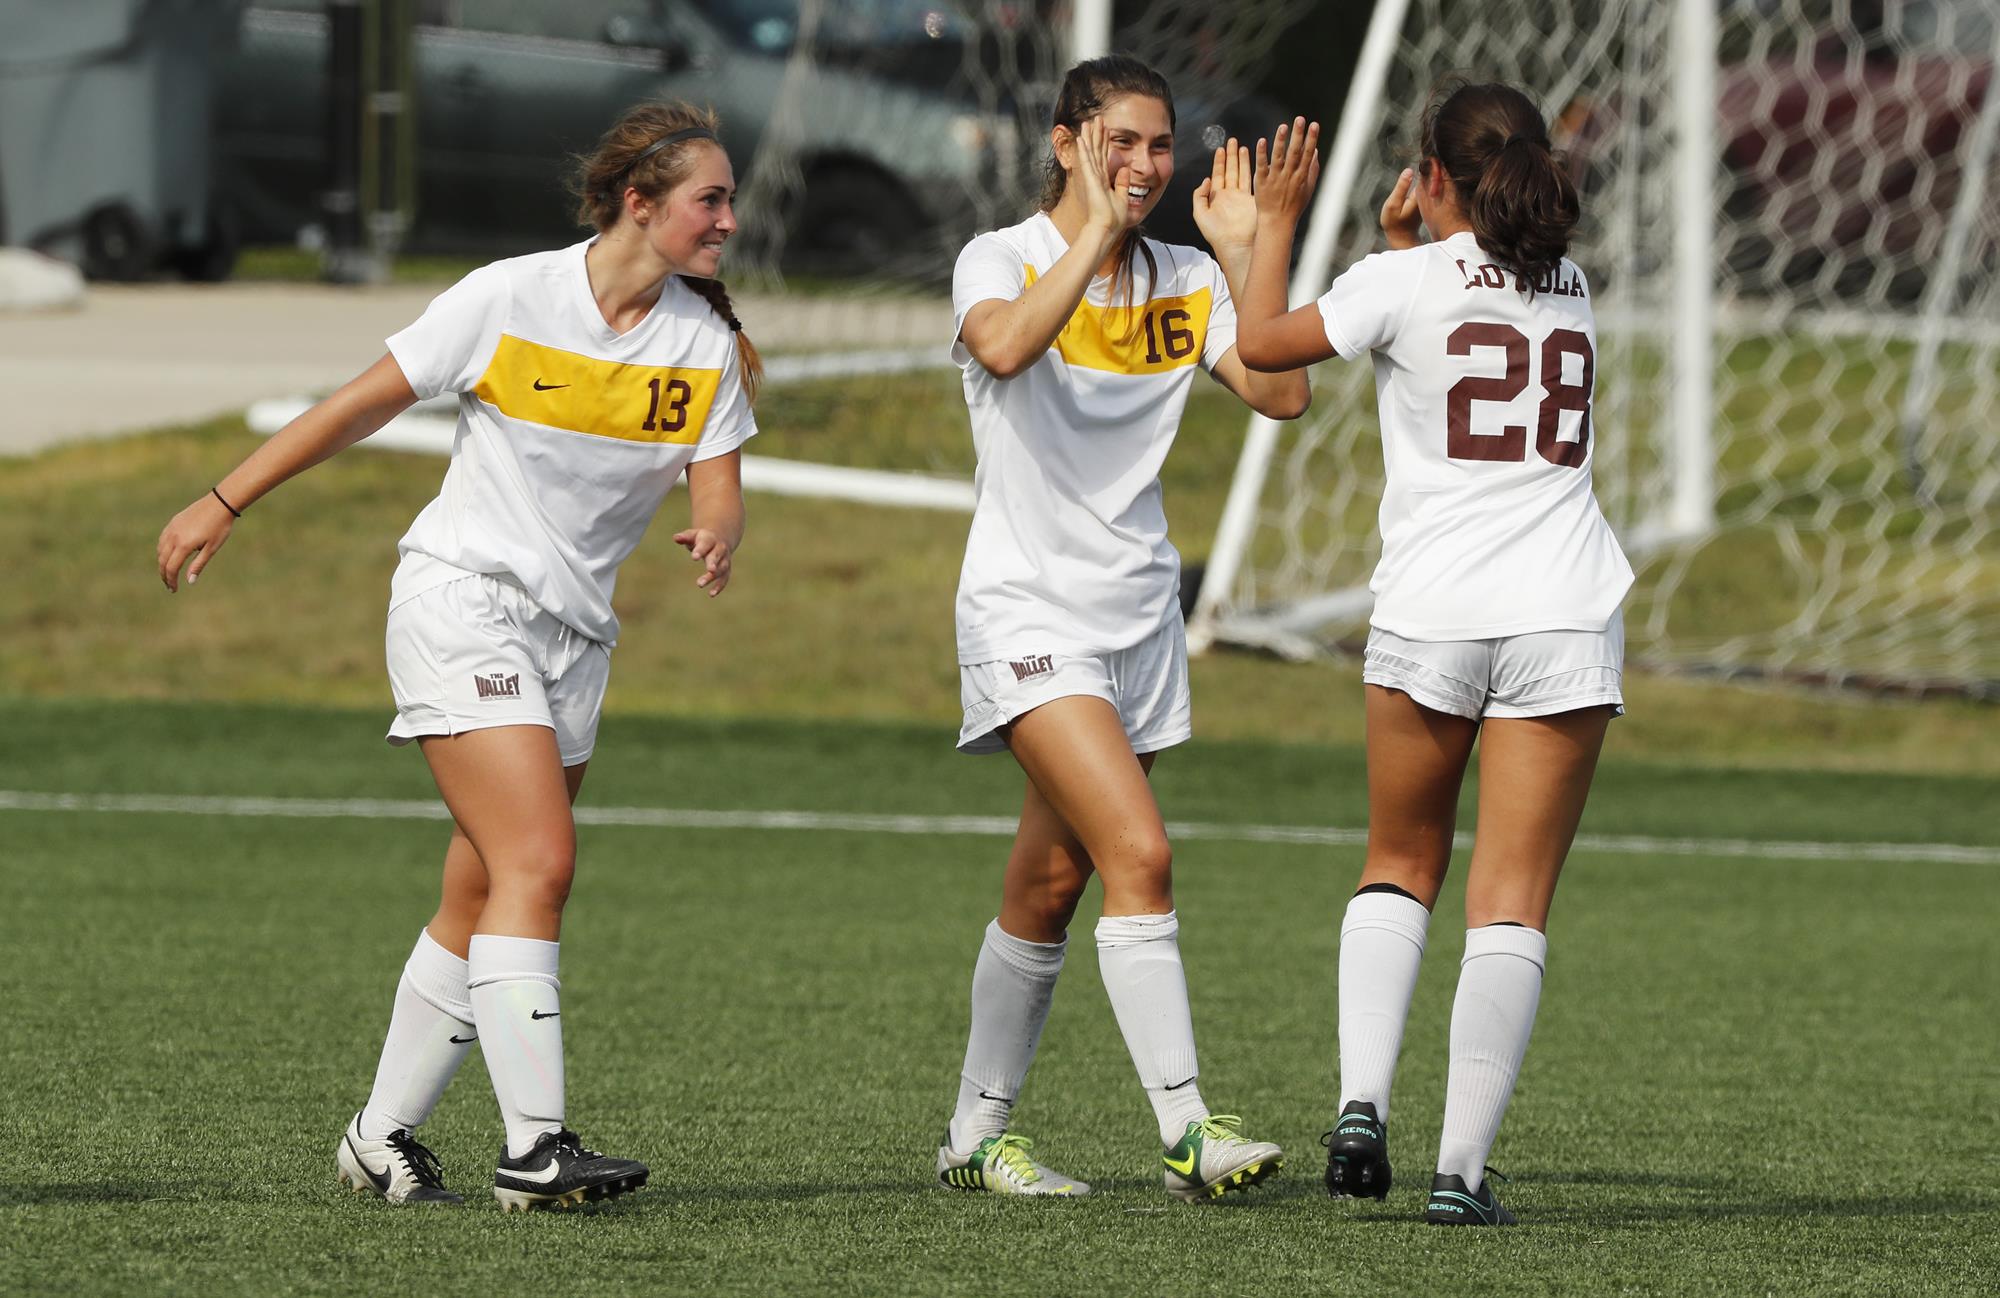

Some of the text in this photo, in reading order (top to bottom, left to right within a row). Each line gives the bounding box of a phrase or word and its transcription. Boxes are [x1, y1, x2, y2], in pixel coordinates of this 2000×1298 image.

[1144, 308, 1196, 364] 16
[641, 377, 692, 433] 13
[1446, 321, 1595, 470] 28
[1009, 653, 1054, 681] VALLEY
[1022, 654, 1036, 662] THE
[473, 672, 520, 697] VALLEY
[1339, 1126, 1377, 1139] TIEMPO
